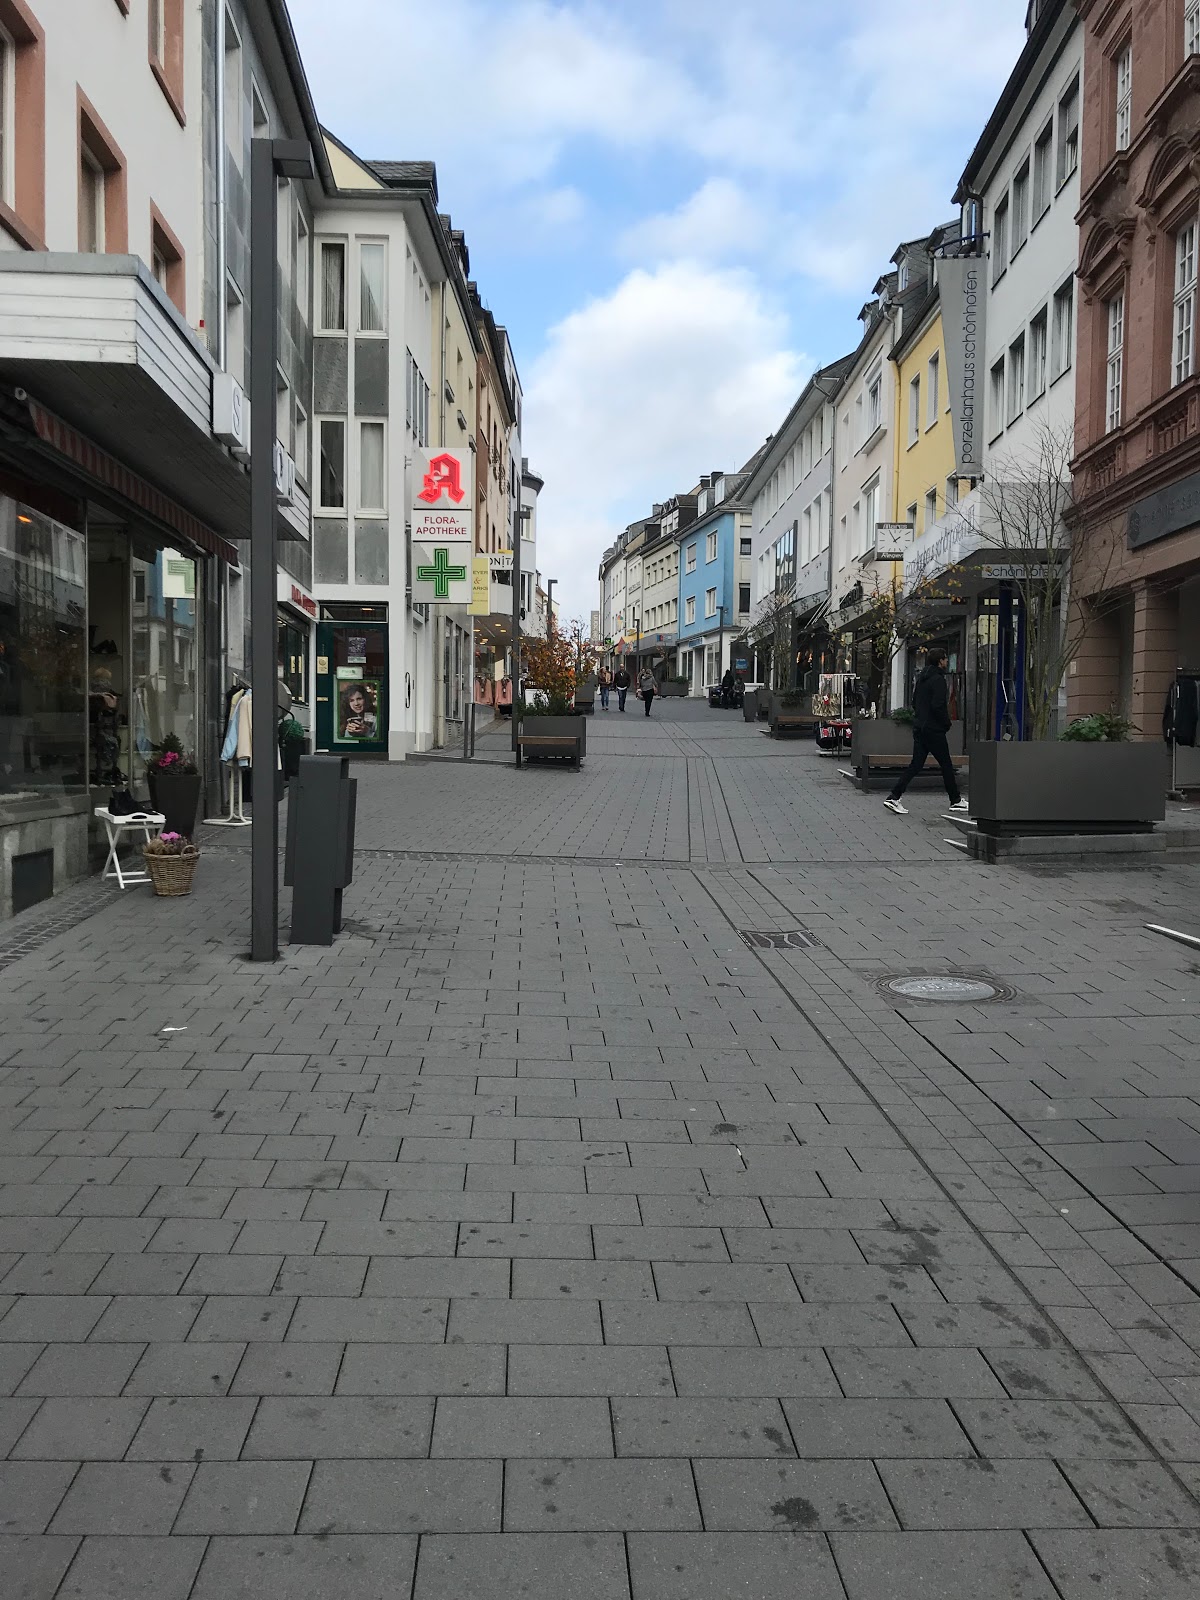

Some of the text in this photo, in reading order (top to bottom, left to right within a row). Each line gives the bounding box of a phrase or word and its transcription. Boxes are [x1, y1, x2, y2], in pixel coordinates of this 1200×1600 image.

[960, 270, 978, 464] porzellanhaus schönhofen
[424, 516, 460, 524] FLORA-
[416, 527, 467, 535] APOTHEKE
